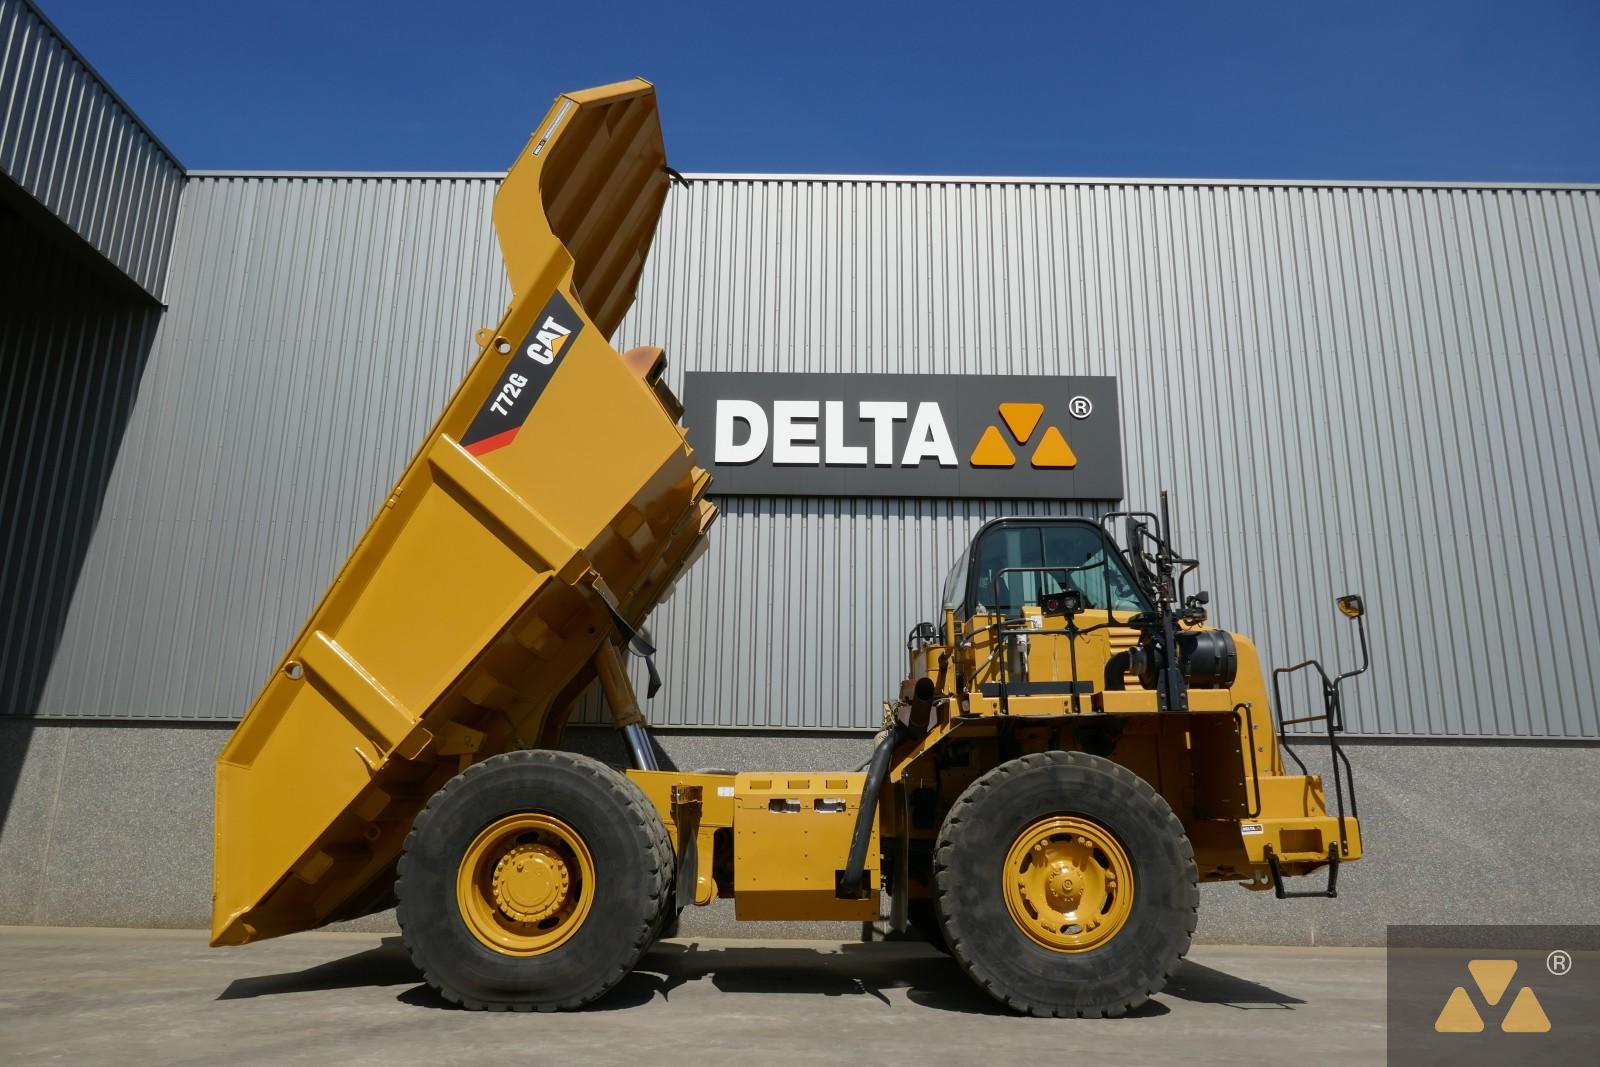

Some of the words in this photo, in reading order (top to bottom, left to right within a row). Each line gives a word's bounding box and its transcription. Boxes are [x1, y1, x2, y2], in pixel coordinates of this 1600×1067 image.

[490, 373, 528, 416] 772G
[526, 316, 572, 365] CAT
[714, 399, 959, 466] DELTA
